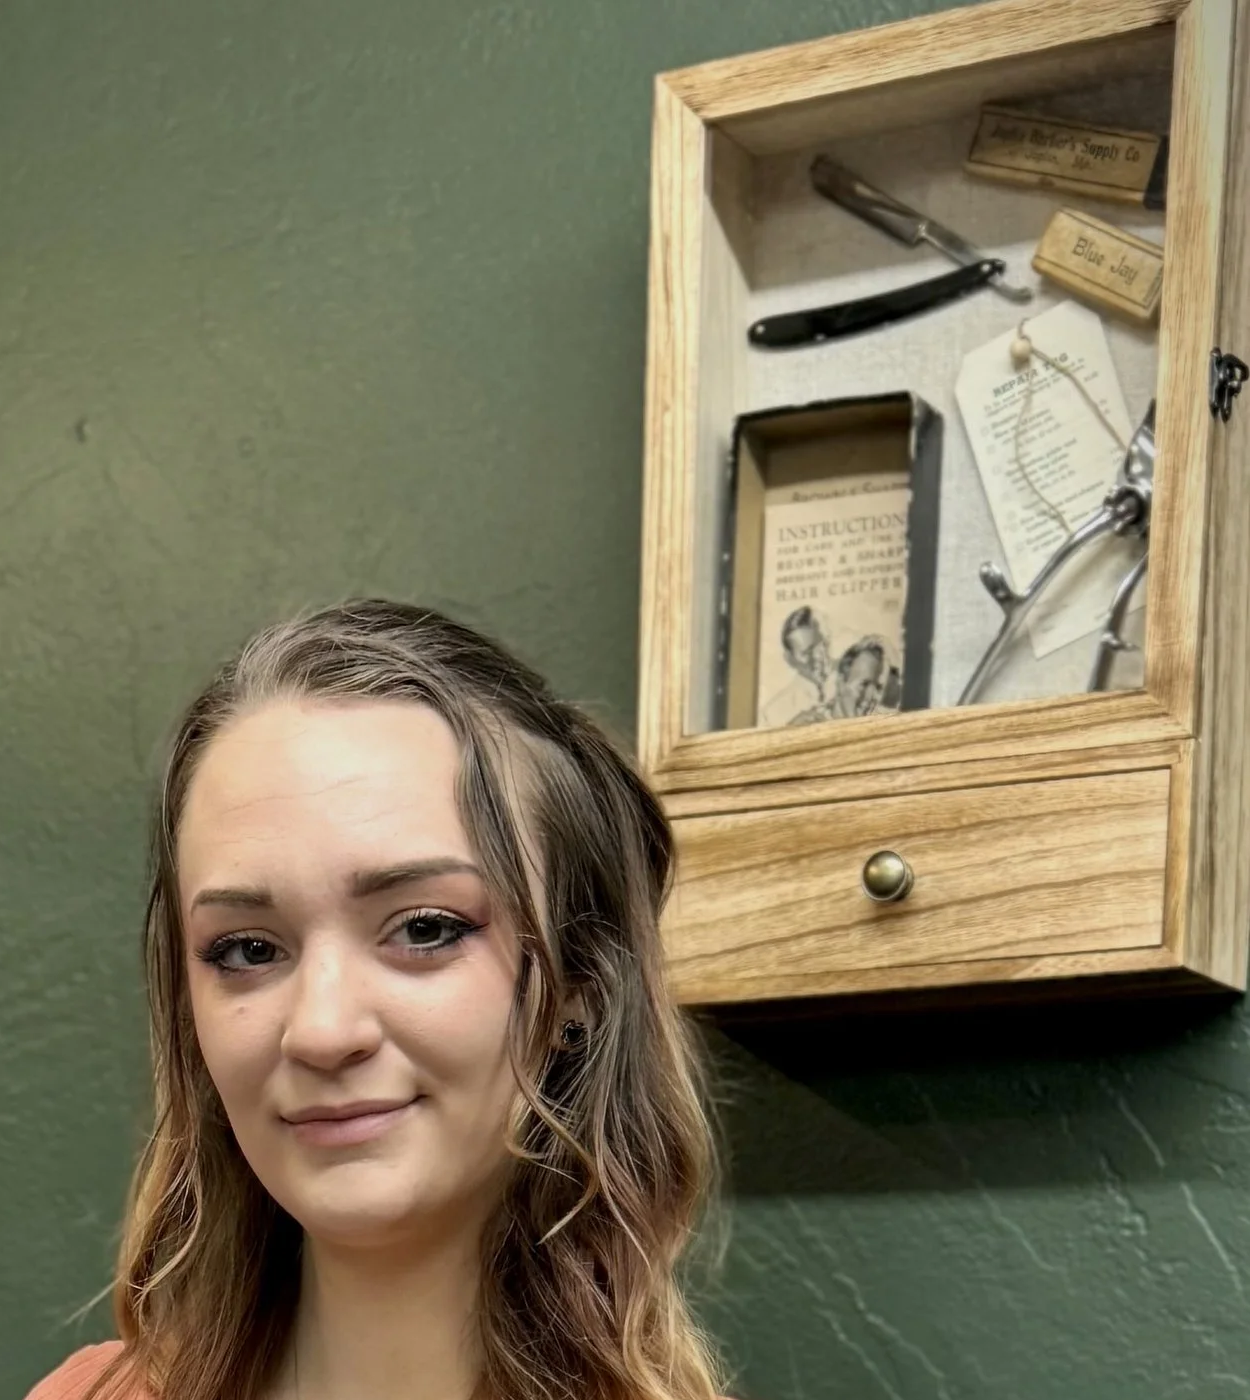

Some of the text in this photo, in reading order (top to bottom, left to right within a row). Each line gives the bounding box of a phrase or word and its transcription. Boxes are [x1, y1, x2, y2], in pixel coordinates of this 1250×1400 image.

[1082, 135, 1119, 163] Supply
[1071, 236, 1139, 286] Blue Jay
[992, 367, 1038, 399] REPAIR
[775, 586, 818, 601] HAIR
